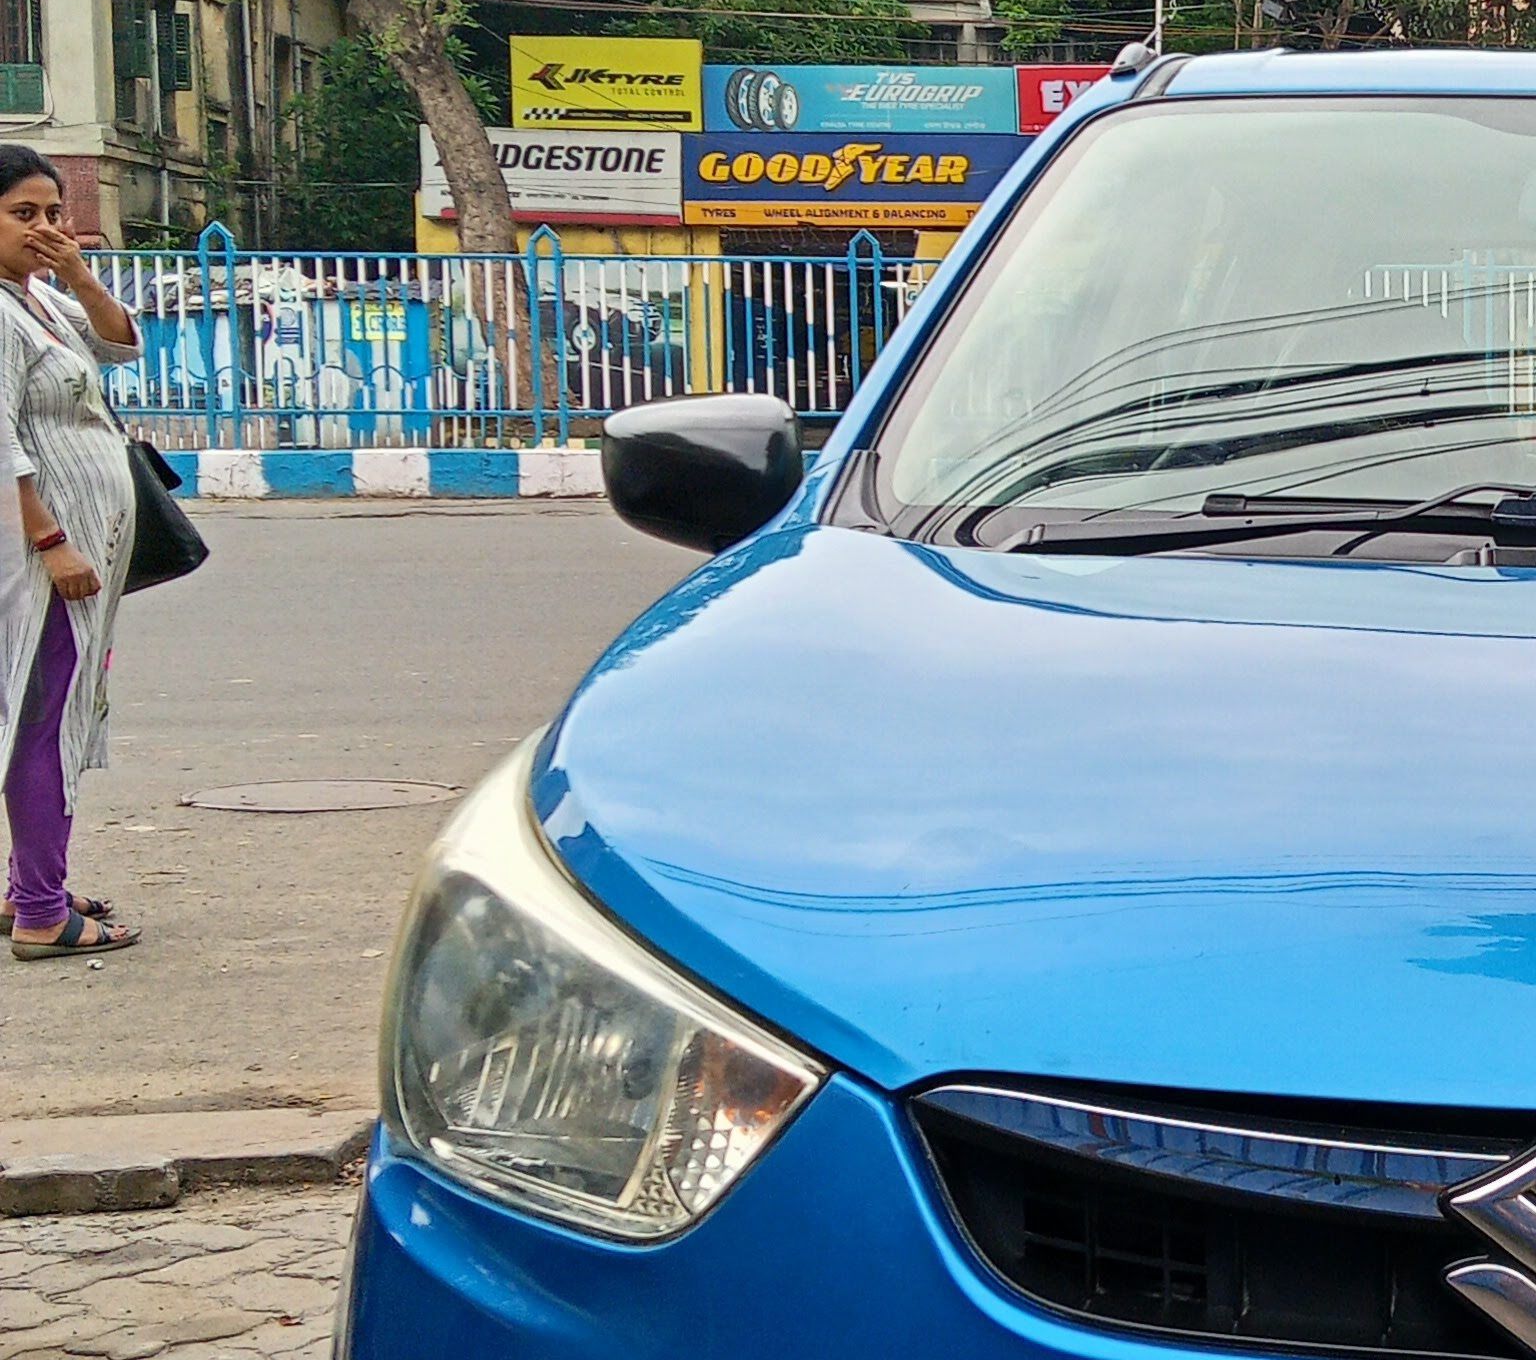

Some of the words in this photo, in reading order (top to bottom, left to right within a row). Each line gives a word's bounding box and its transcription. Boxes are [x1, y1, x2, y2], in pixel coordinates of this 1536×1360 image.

[875, 71, 917, 84] TVS
[841, 83, 985, 103] EUROGRIP
[701, 208, 736, 218] TYRES
[763, 208, 802, 218] WHEEL
[804, 208, 869, 219] ALIGNMENT
[883, 209, 947, 219] BALANCING
